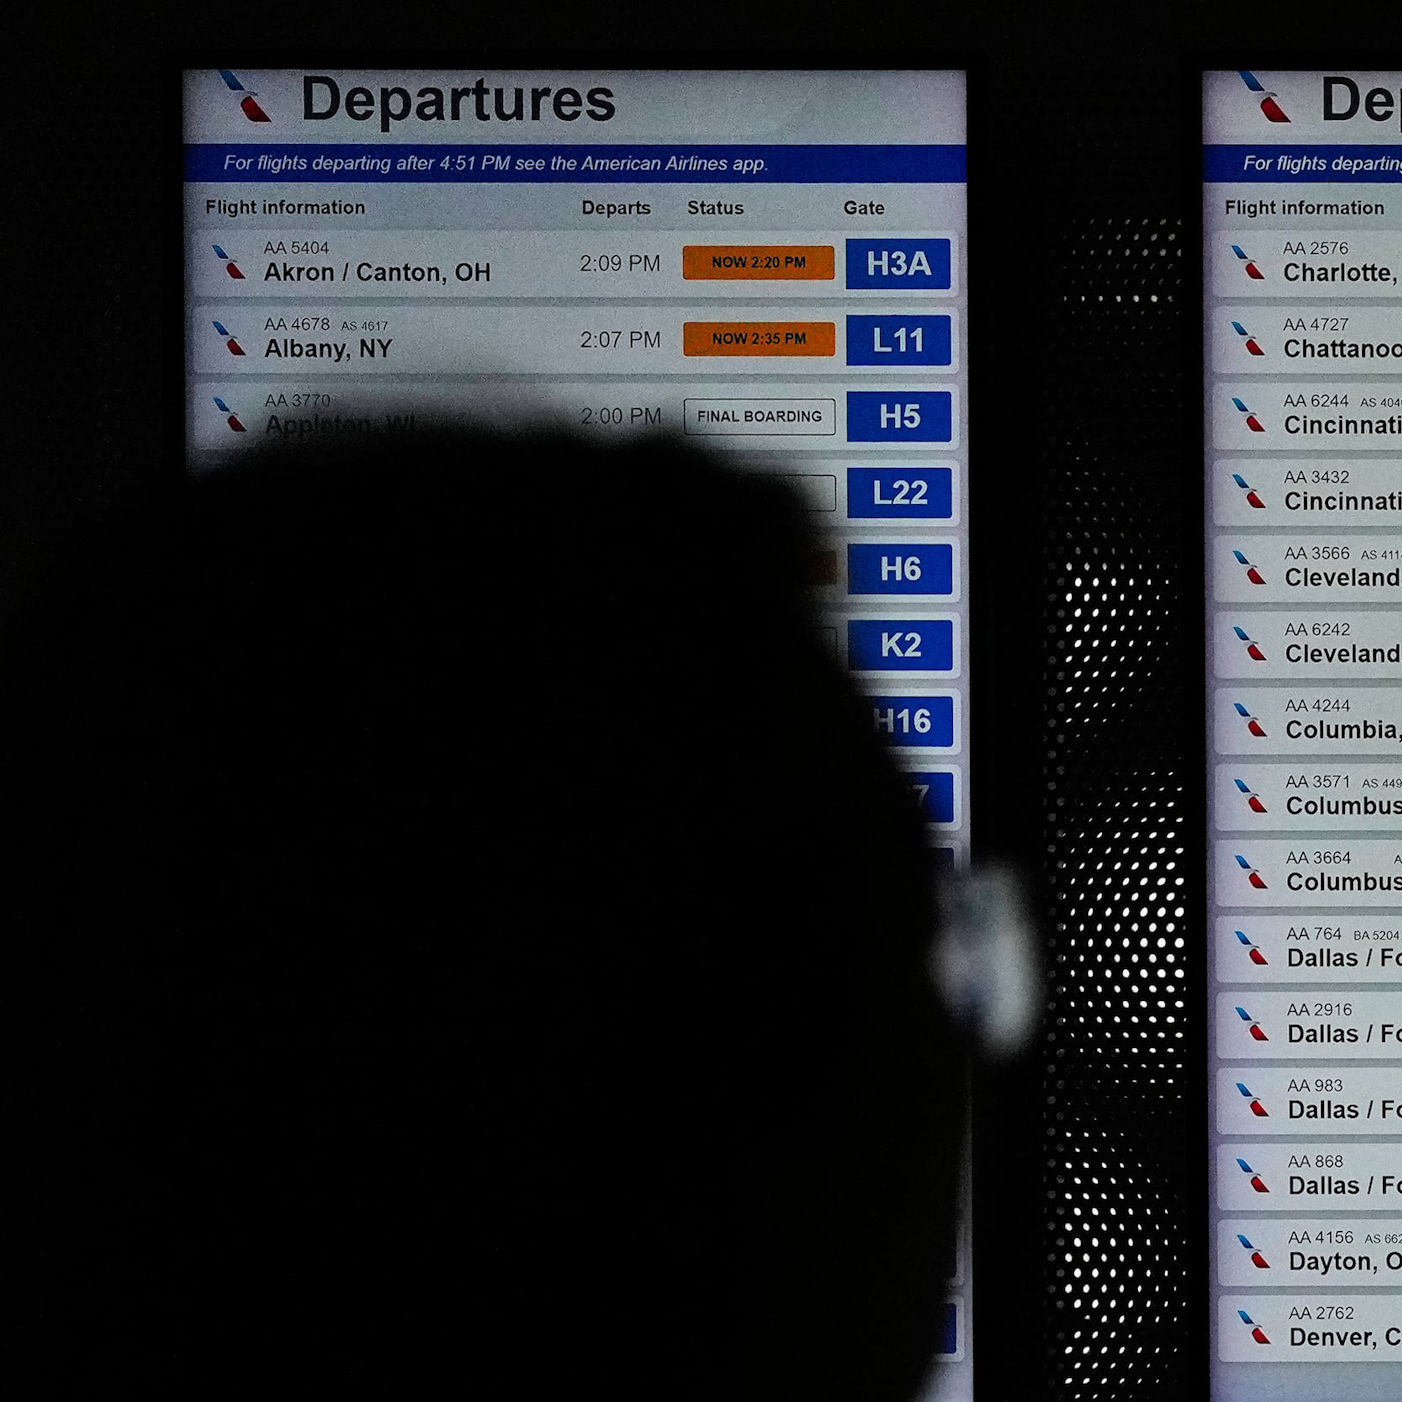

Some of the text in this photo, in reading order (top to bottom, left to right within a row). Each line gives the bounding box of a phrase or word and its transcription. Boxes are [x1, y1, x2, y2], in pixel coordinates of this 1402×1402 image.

[302, 74, 616, 133] Departures
[223, 154, 768, 175] For flights departing after 4:51 PM see the American Airlines app.
[205, 198, 366, 218] Flight information
[582, 199, 651, 219] Departs
[687, 200, 745, 215] Status
[843, 200, 885, 216] Gate
[263, 240, 329, 255] AA 5404
[1283, 241, 1349, 256] AA 2576
[580, 254, 661, 272] 2:09 PM
[711, 255, 806, 269] NOW 2:20 PM
[867, 250, 932, 276] H3A
[1283, 262, 1397, 285] Charlotte,
[263, 317, 331, 332] AA 4678
[340, 320, 389, 332] AS 4617
[873, 327, 923, 352] L11
[264, 338, 393, 363] Albany, NY
[1283, 393, 1349, 408] AA 6244
[1359, 397, 1378, 408] AS
[696, 410, 822, 424] FINAL BOARDING
[880, 403, 921, 429] H5
[873, 479, 928, 505] L22
[881, 556, 922, 581] H6
[881, 632, 922, 658] K2
[1289, 1251, 1378, 1276] Dayton,
[1290, 1327, 1377, 1350] Denver,
